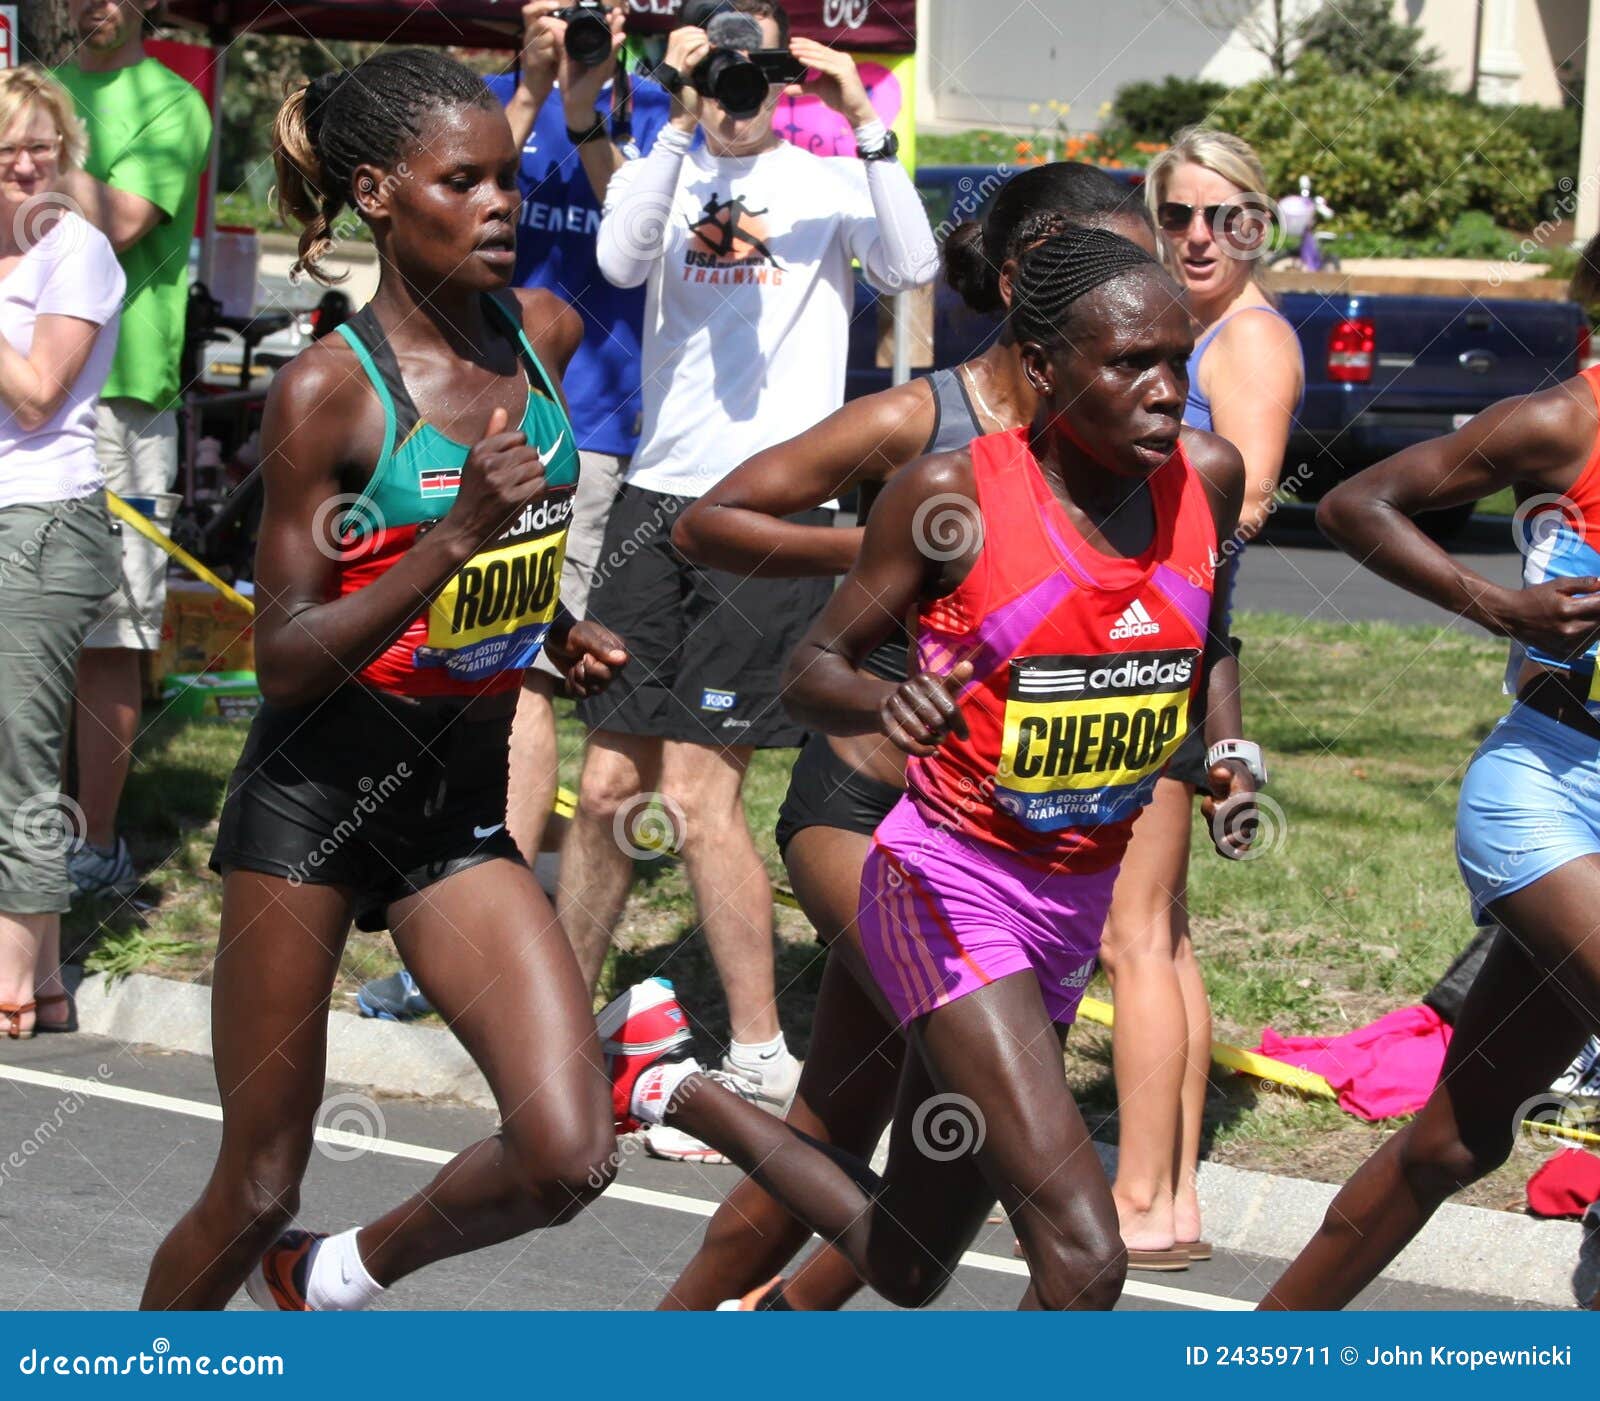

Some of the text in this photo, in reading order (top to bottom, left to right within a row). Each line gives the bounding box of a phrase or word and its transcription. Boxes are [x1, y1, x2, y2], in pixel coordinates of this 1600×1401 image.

[685, 250, 718, 268] USA
[683, 266, 783, 286] TRAINING
[451, 546, 558, 635] RONO
[1109, 622, 1160, 640] adidas
[1089, 659, 1192, 689] adidas
[1013, 704, 1180, 779] CHEROP
[1029, 797, 1053, 809] 2012
[1056, 793, 1101, 804] BOSTON
[1026, 803, 1098, 820] MARATHON
